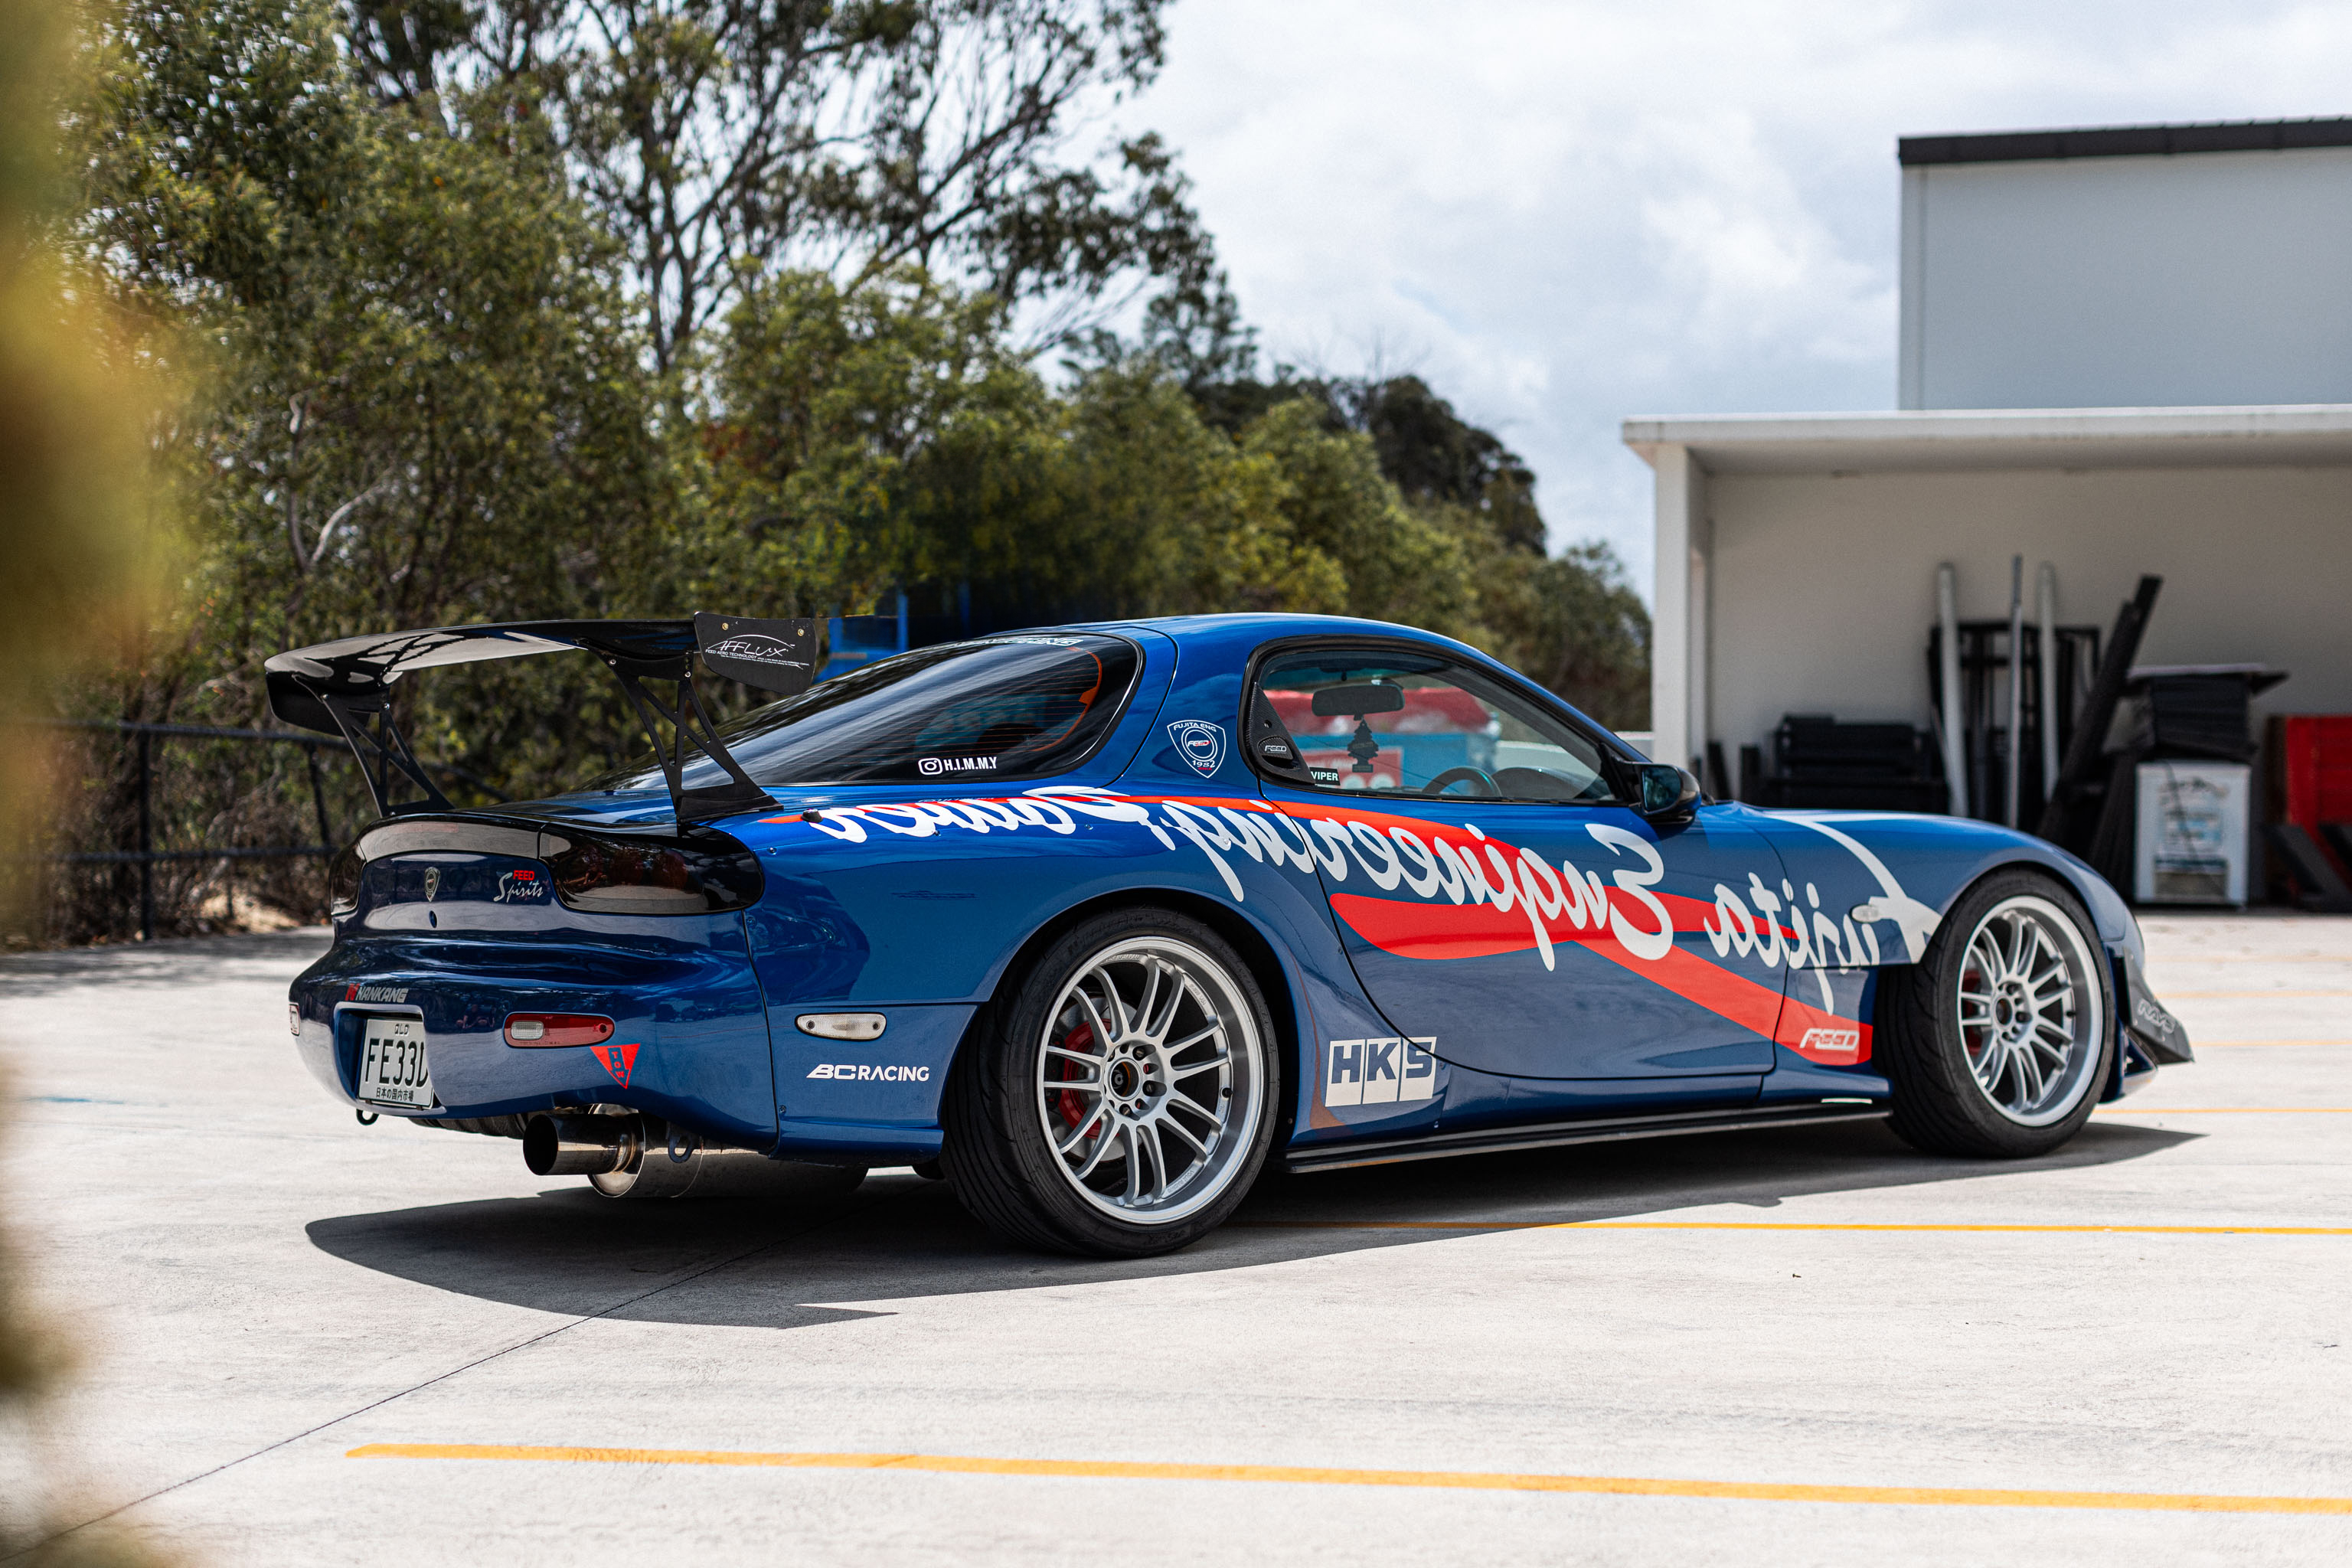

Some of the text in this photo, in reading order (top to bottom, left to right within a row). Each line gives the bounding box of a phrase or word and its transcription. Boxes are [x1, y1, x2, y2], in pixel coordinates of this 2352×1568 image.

[1174, 722, 1217, 733] FUJITA ENG
[943, 756, 997, 771] H.I.M.M.Y
[1192, 760, 1216, 768] 1982
[1311, 771, 1338, 781] VIPER
[513, 870, 535, 880] FEED
[493, 872, 544, 903] Spirits
[355, 986, 409, 1003] NANKANG
[394, 1024, 410, 1035] QLD
[1800, 1027, 1860, 1050] FEED
[611, 1051, 625, 1078] TOW
[1330, 1040, 1435, 1086] HKS
[858, 1065, 929, 1082] RACING
[376, 1087, 414, 1102] 日本の国内市場
